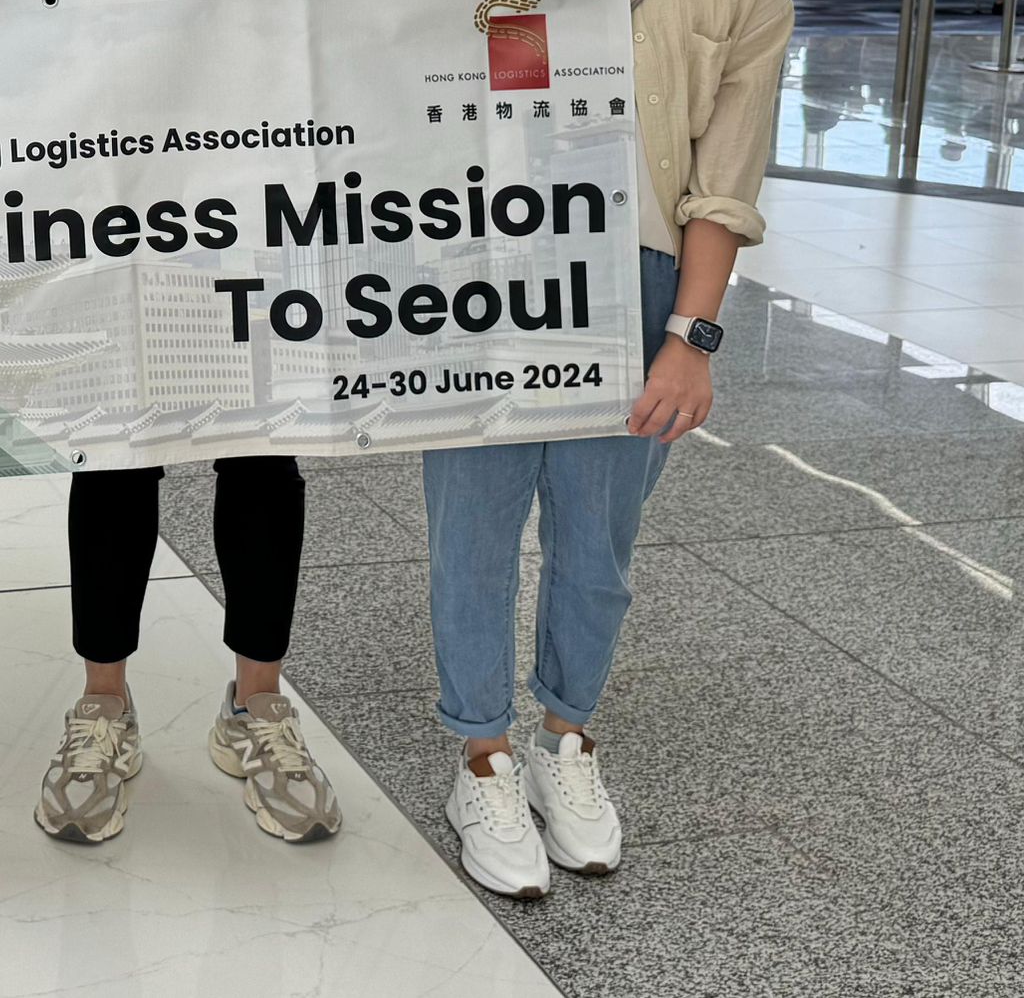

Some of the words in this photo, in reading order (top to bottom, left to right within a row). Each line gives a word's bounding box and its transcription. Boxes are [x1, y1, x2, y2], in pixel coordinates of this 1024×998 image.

[425, 73, 455, 83] HONG
[458, 72, 487, 81] KONG
[494, 68, 546, 80] LOGISTICS
[554, 66, 625, 77] ASSOCIATION
[10, 130, 154, 169] Logistics
[162, 118, 356, 153] Association
[264, 165, 606, 248] Mission
[215, 278, 323, 342] To
[345, 261, 589, 338] Seoul
[332, 369, 427, 401] 24-30
[436, 367, 514, 394] June
[523, 362, 603, 390] 2024
